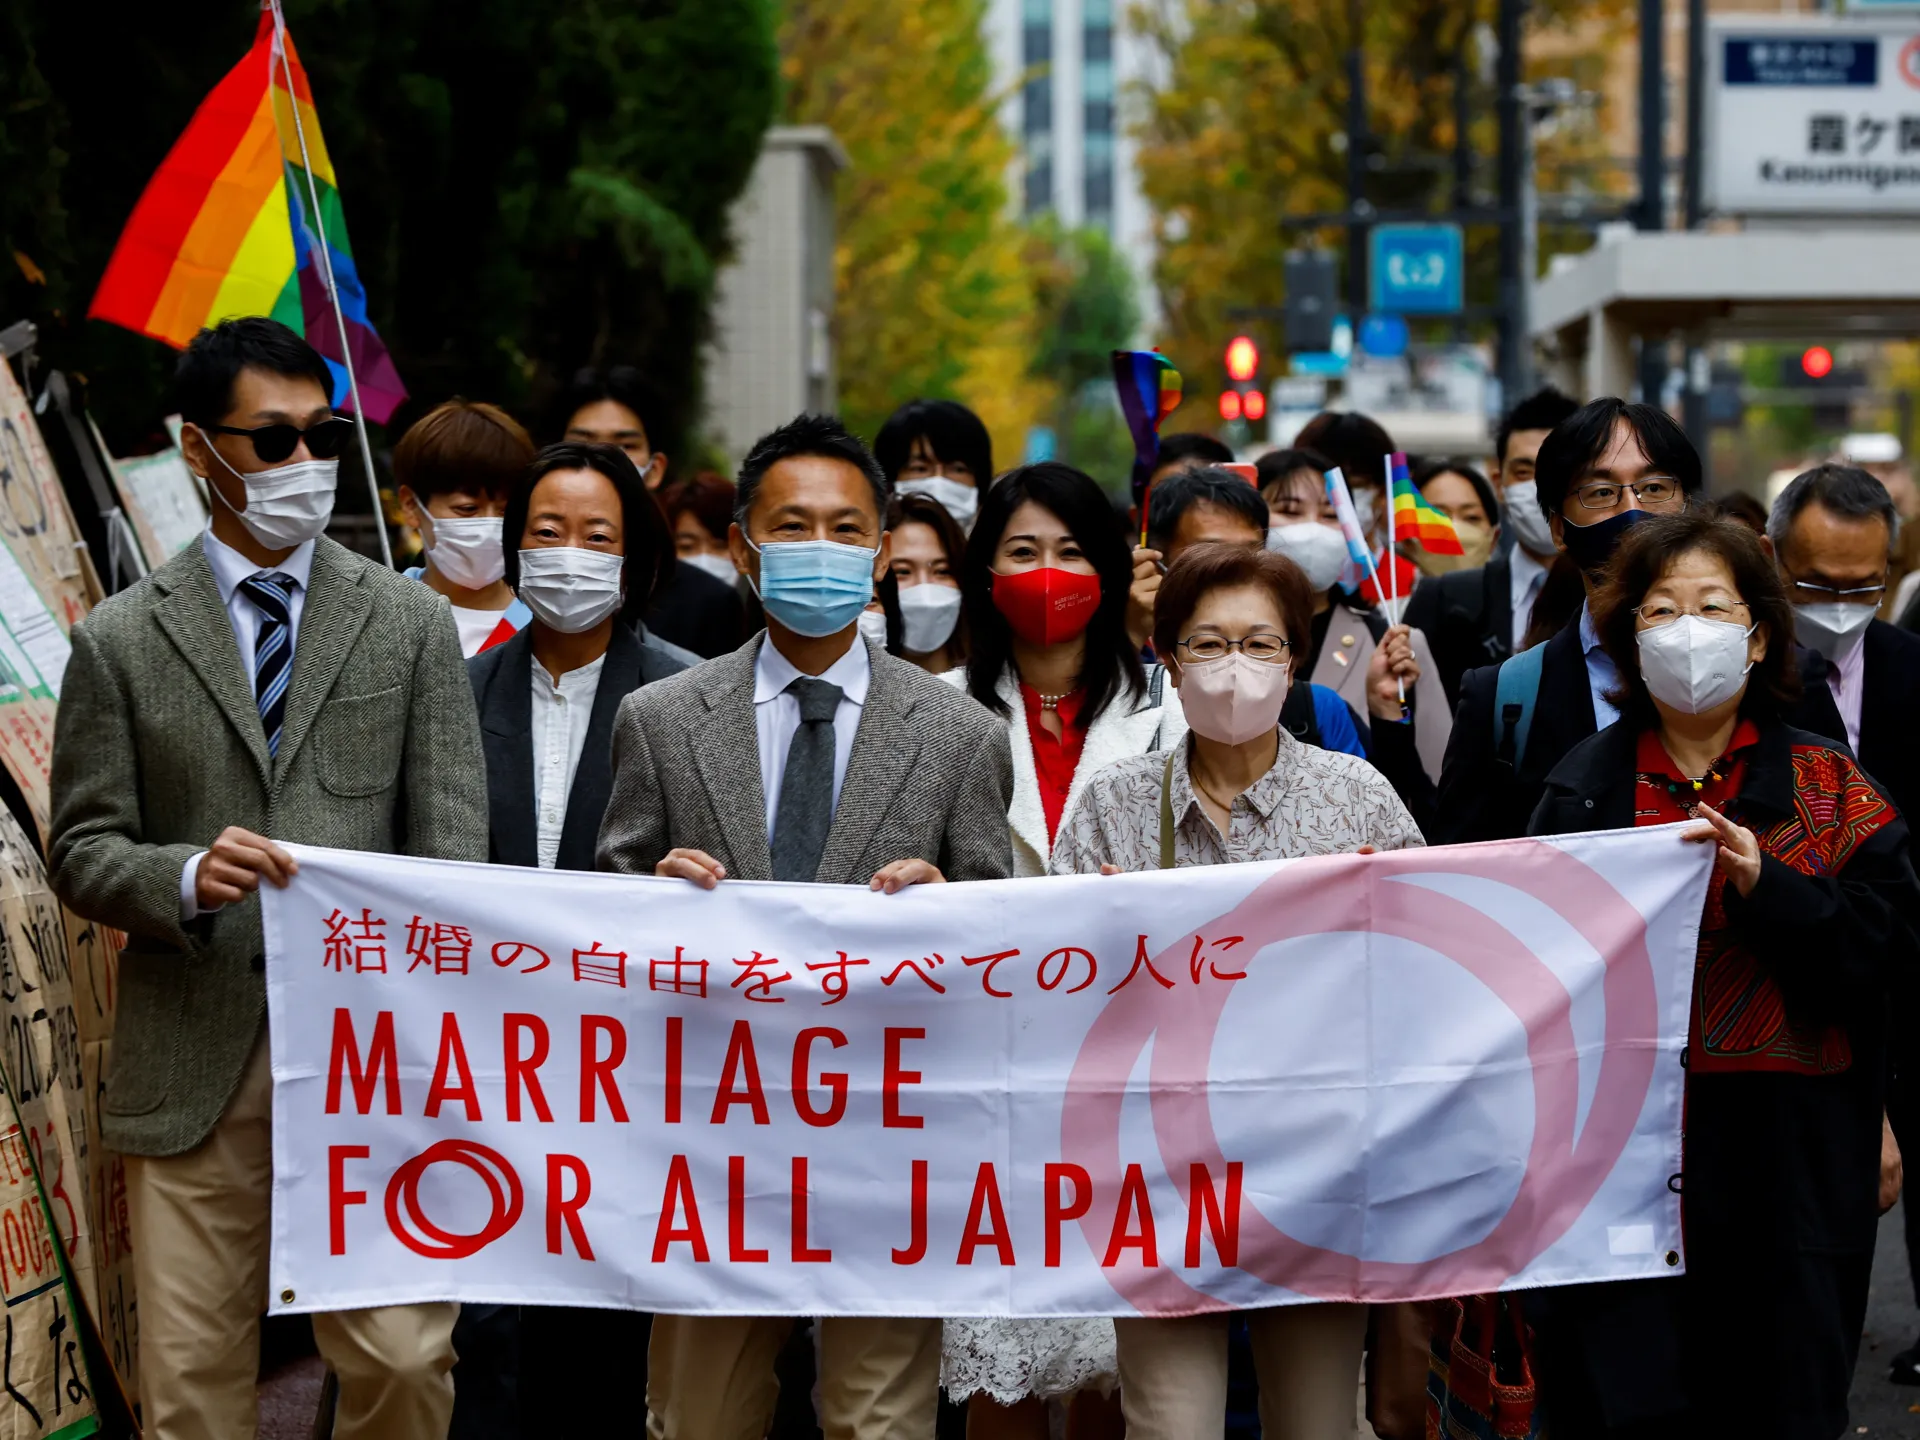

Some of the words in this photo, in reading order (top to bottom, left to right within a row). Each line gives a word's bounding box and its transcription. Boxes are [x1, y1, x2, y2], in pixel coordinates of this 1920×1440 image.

[322, 908, 1247, 1006] 結婚の自由をすべての人に
[324, 1007, 926, 1129] MARRIAGE
[327, 1138, 596, 1262] FOR
[651, 1153, 832, 1264] ALL
[891, 1160, 1244, 1269] JAPAN
